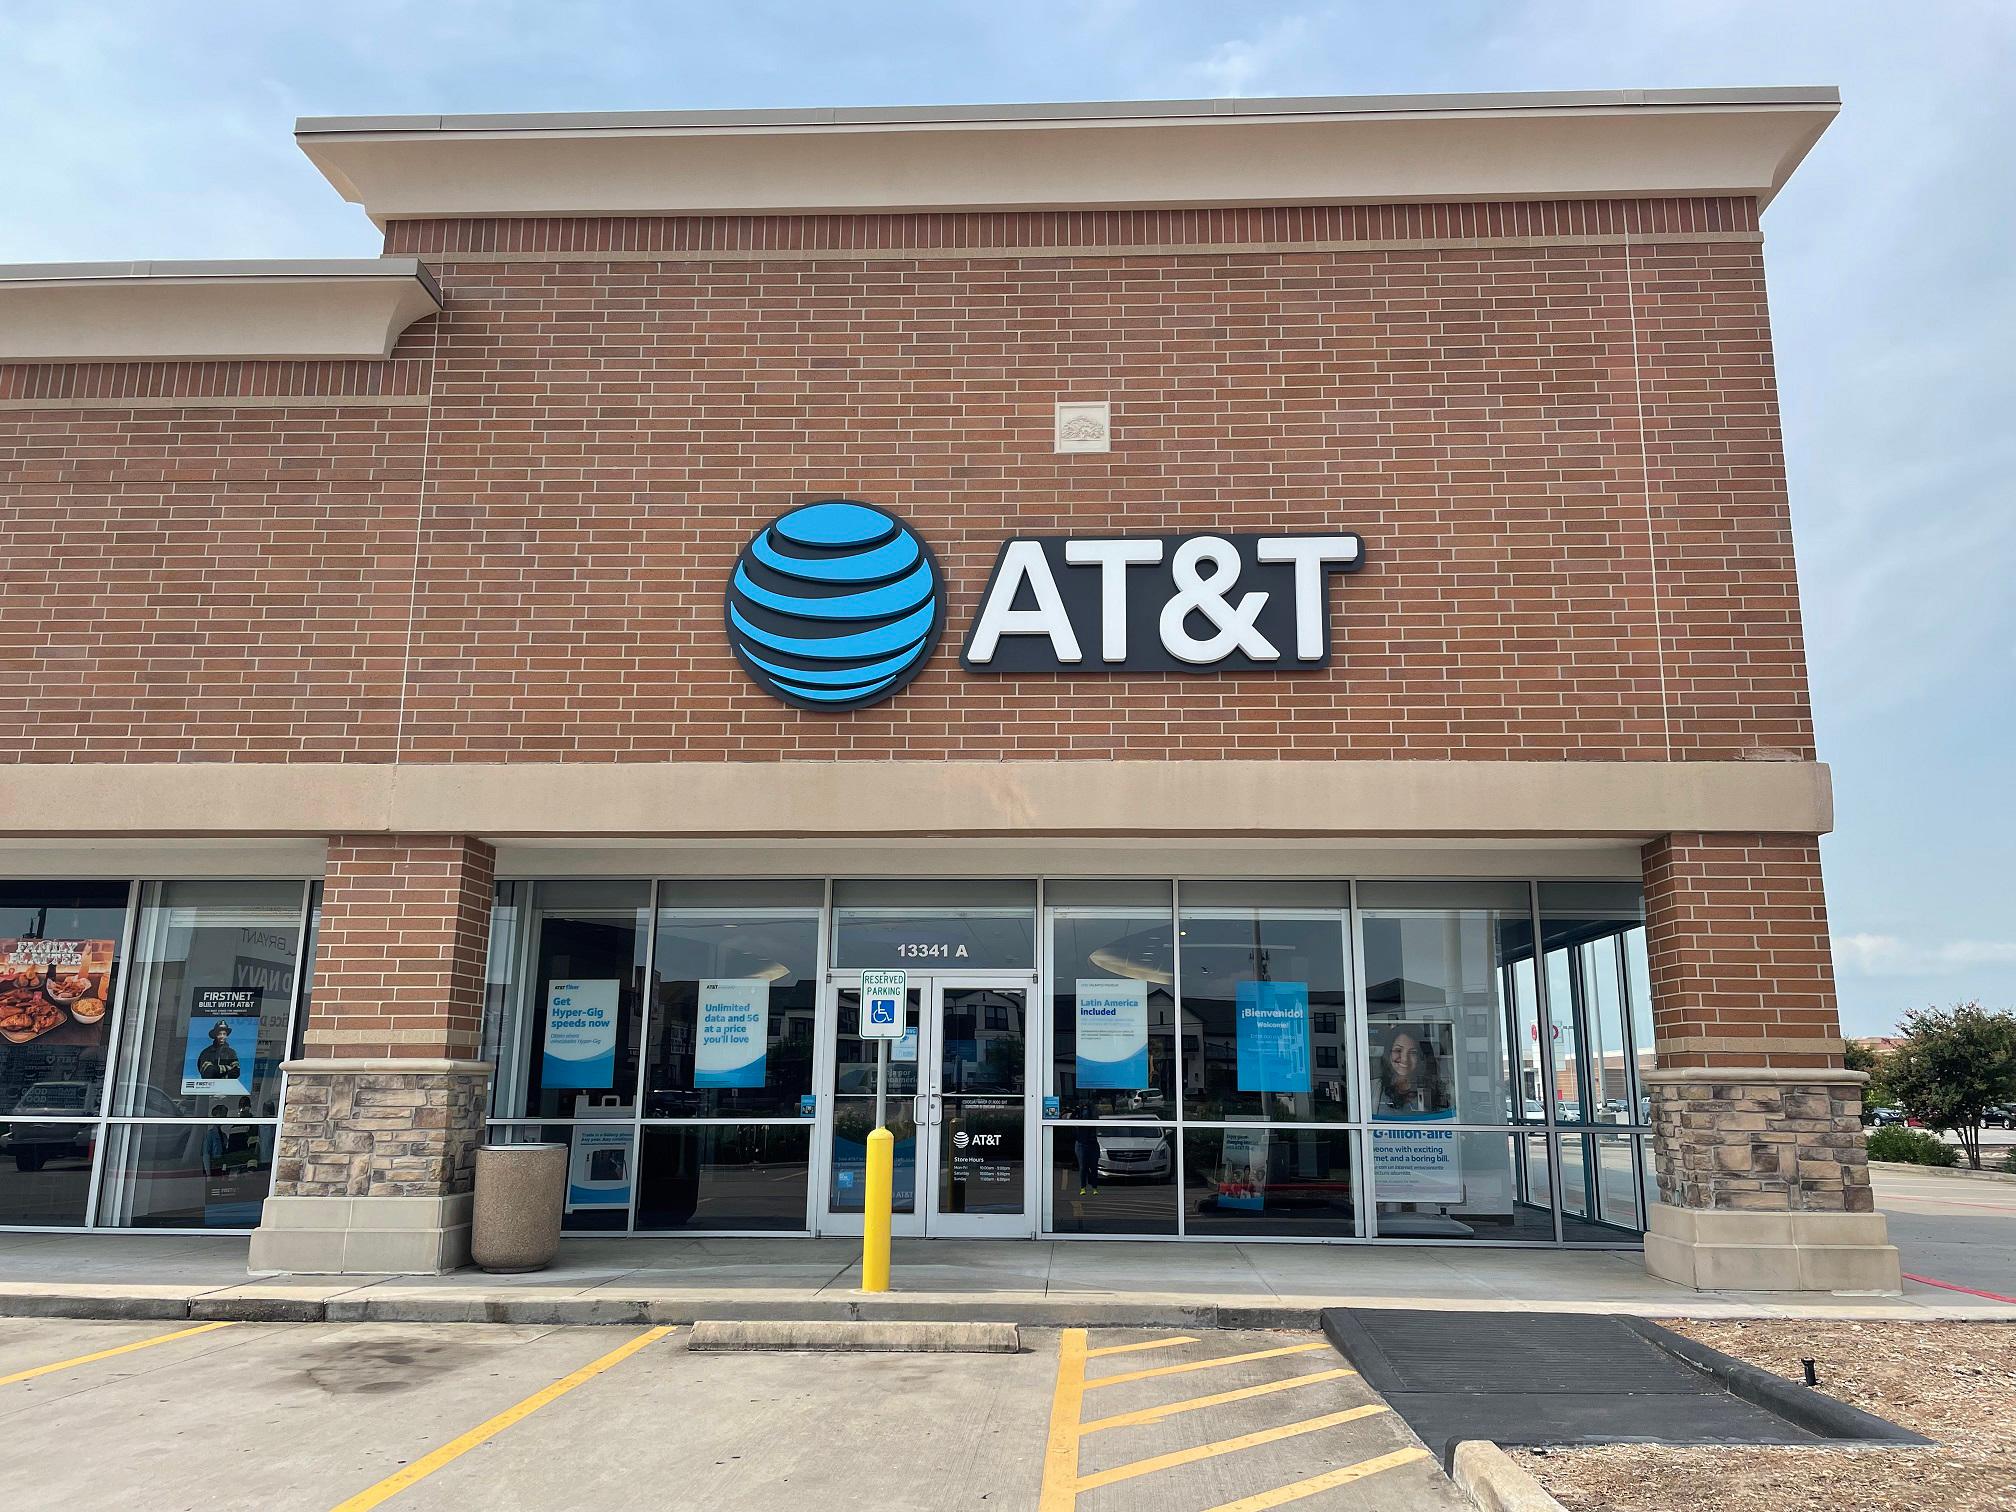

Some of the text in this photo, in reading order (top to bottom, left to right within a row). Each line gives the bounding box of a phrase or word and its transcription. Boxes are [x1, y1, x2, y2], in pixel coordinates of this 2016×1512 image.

[966, 535, 1359, 665] AT&T
[16, 941, 78, 953] FAMILY
[897, 943, 969, 957] 13341 A
[8, 953, 82, 965] PLATTER
[864, 975, 904, 984] RESERVED
[203, 991, 255, 1001] FIRSTNET
[866, 987, 901, 996] PARKING
[553, 997, 571, 1006] Get
[1080, 999, 1139, 1007] Latin America
[705, 1003, 751, 1012] Unlimited
[1080, 1007, 1117, 1016] included
[552, 1007, 604, 1019] Hyper-Gig
[1241, 1007, 1304, 1019] ¡Bienvenido!
[704, 1014, 760, 1023] data and 5G
[551, 1018, 611, 1030] speeds now
[704, 1025, 714, 1033] at
[723, 1024, 747, 1035] price
[703, 1035, 750, 1046] you'll love
[971, 1134, 1002, 1146] AT&T
[1413, 1146, 1444, 1154] exciting
[1411, 1155, 1436, 1163] boring
